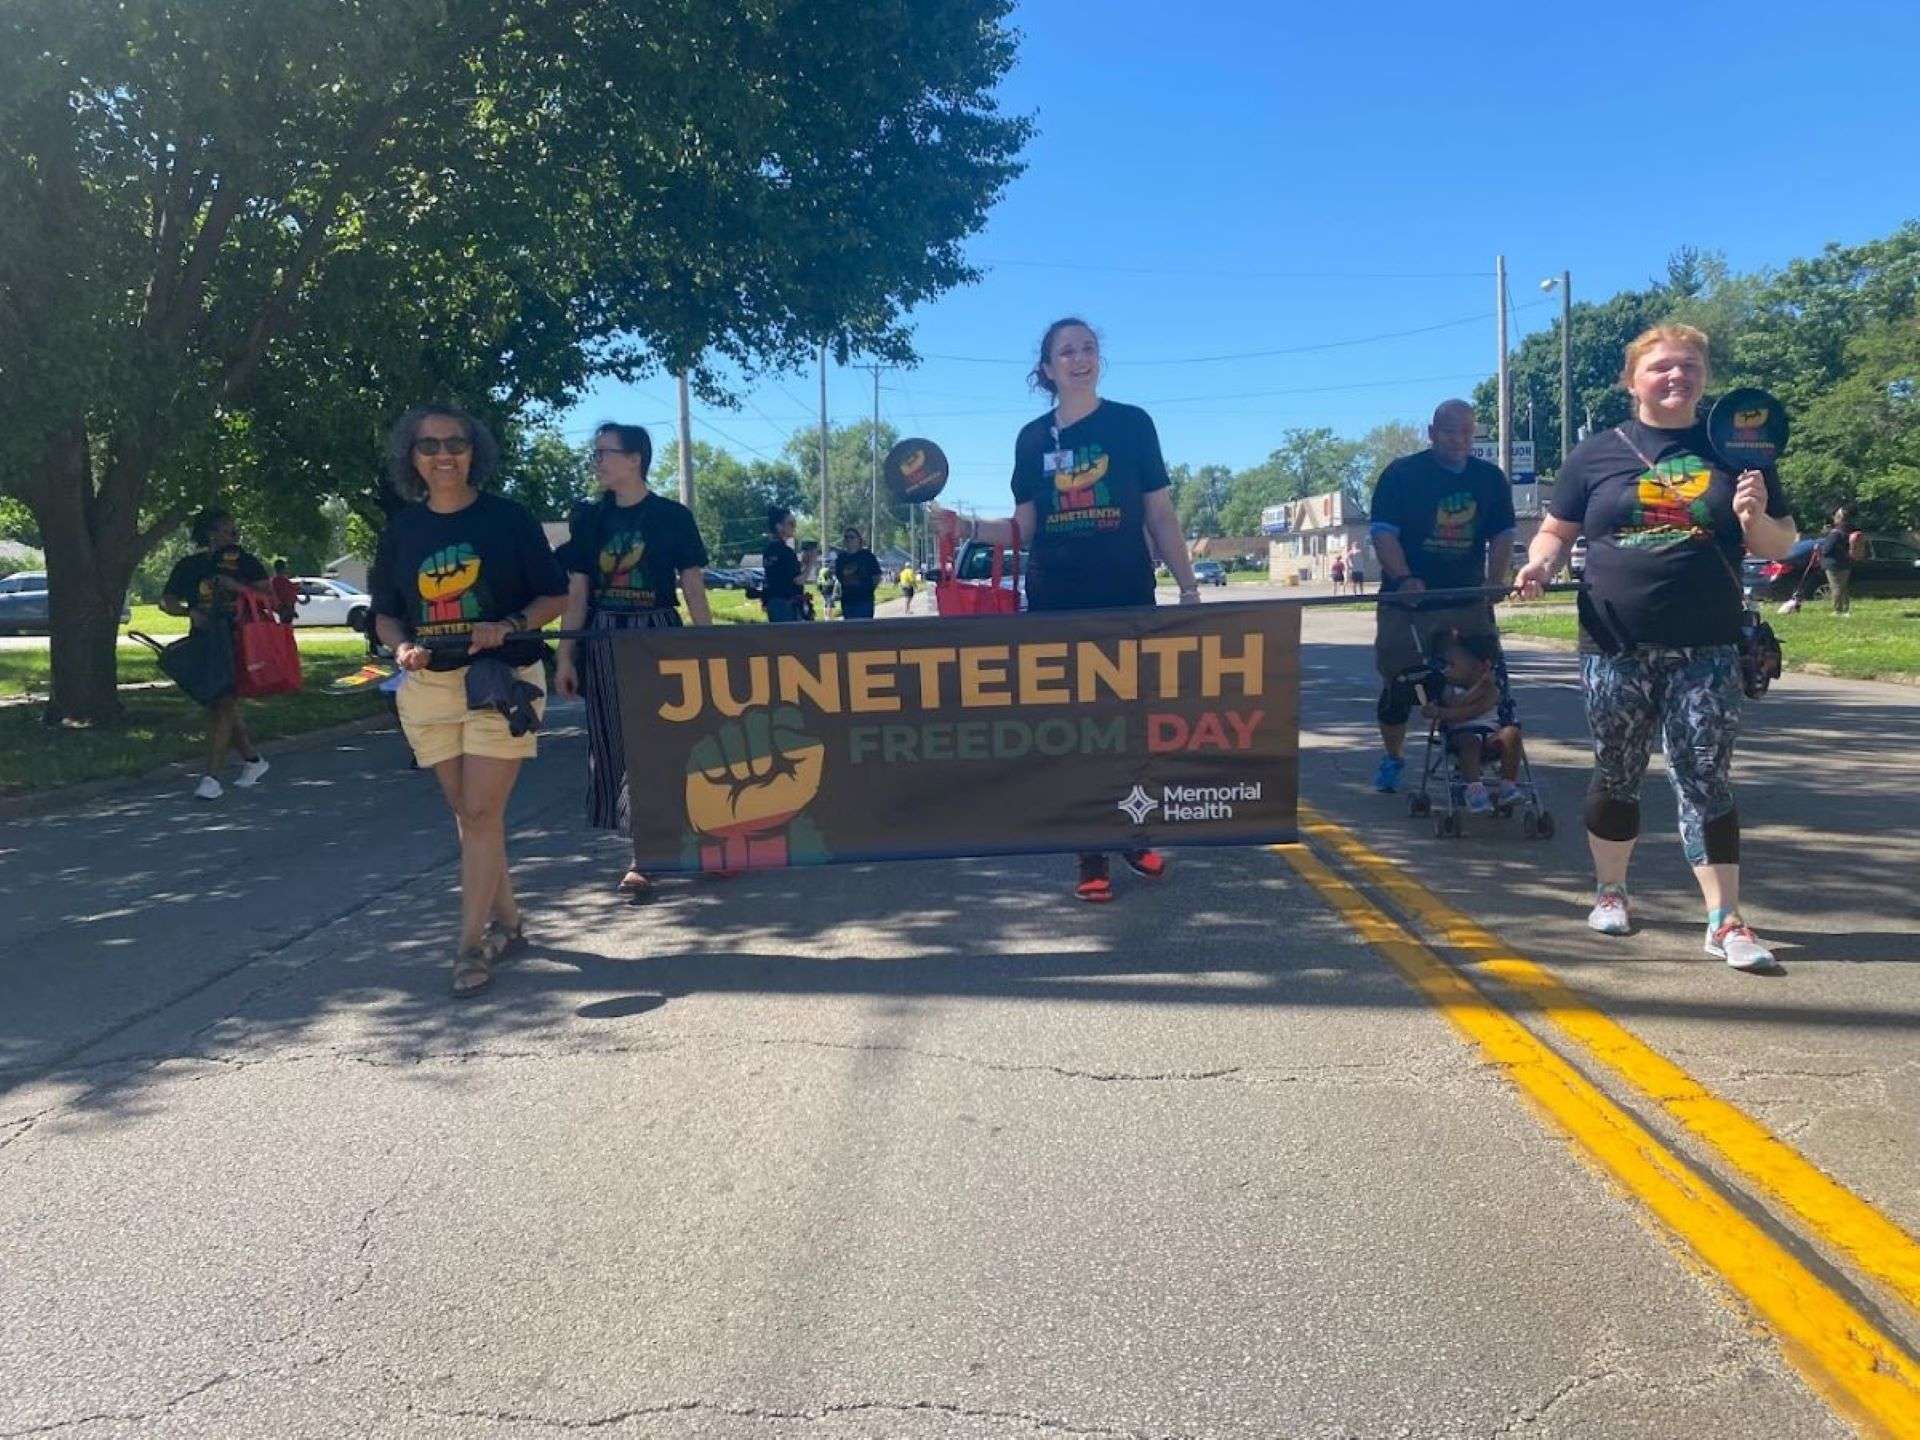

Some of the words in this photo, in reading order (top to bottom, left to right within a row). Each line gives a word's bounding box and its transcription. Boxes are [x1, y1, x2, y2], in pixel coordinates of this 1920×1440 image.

[658, 633, 1264, 722] JUNETEENTH
[850, 715, 1127, 765] FREEDOM
[1146, 709, 1266, 753] DAY
[1163, 781, 1262, 803] Memorial
[1163, 801, 1233, 821] Health
